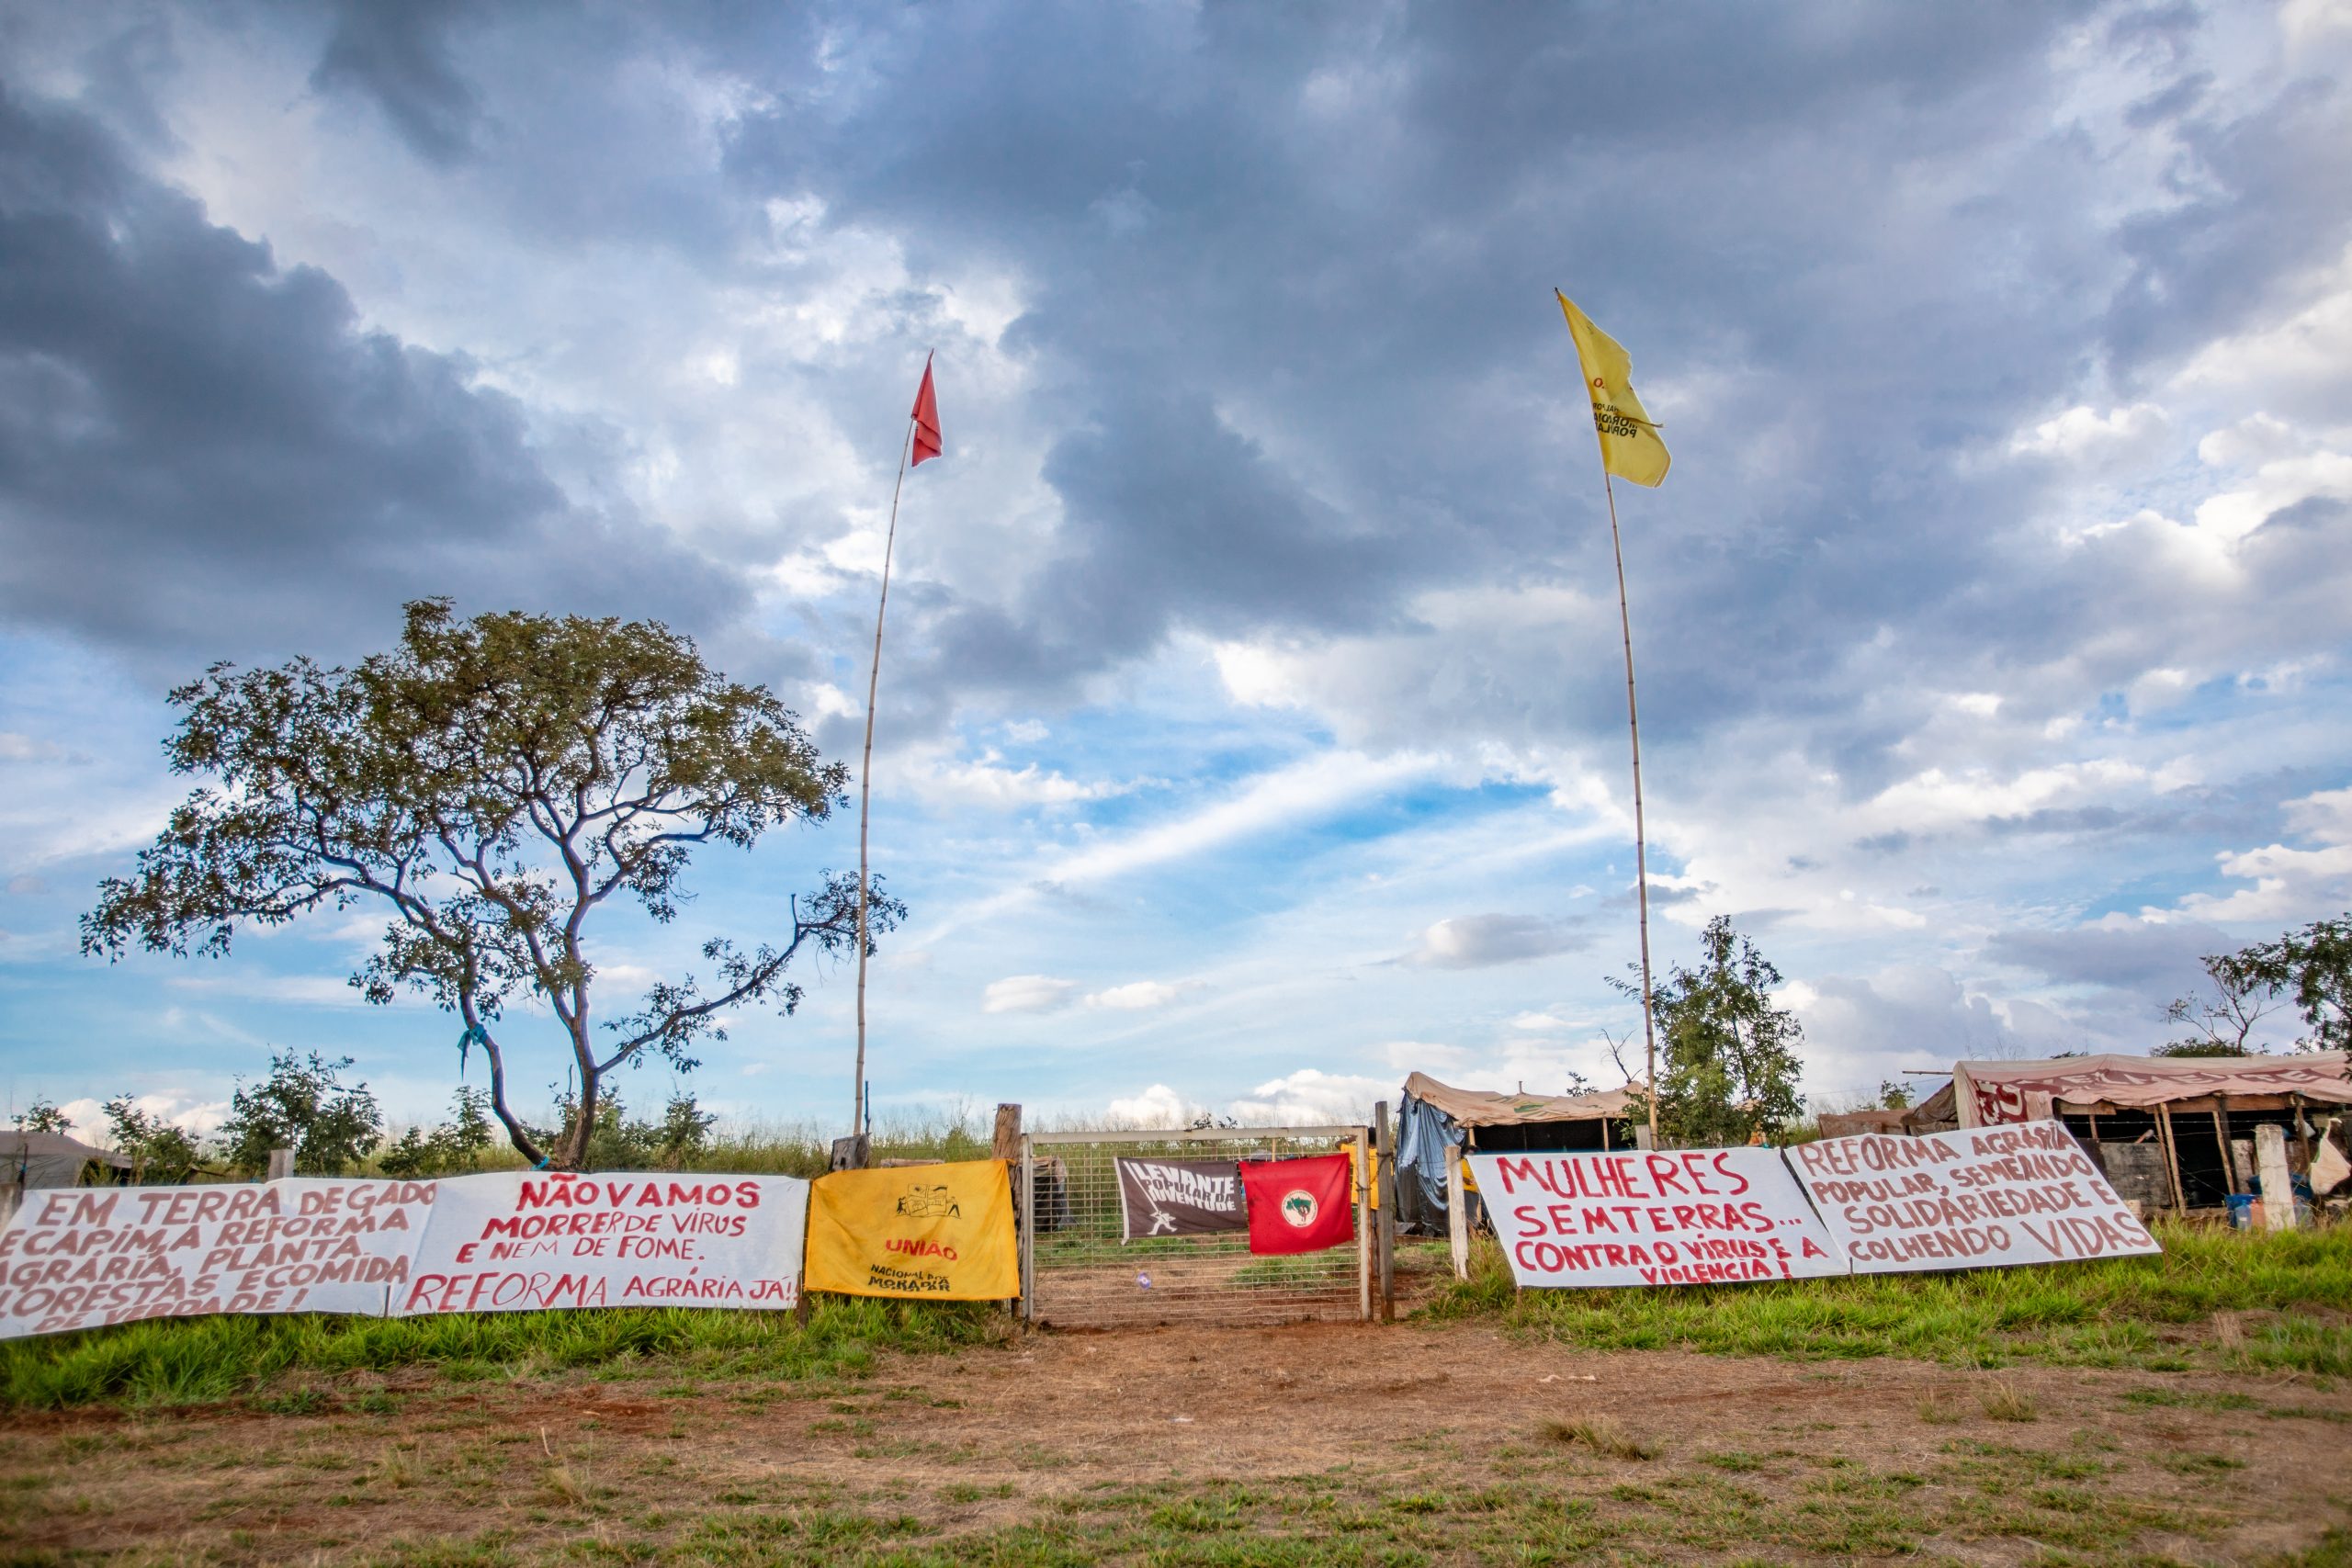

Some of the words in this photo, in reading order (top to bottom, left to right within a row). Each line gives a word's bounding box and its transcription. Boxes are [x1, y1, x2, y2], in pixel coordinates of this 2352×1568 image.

[1497, 1152, 1749, 1199] MULHERES
[1797, 1136, 1962, 1177] REFORMA
[1132, 1161, 1235, 1194] LEVANTE
[1810, 1173, 1950, 1204] POPULAR,
[1950, 1153, 2094, 1188] SEMEANDO
[2088, 1179, 2118, 1205] E
[36, 1192, 120, 1226] EM
[138, 1187, 282, 1224] TERRA
[214, 1208, 409, 1247] REFORMA
[1802, 1236, 1829, 1258] A
[1848, 1225, 2011, 1262] COLHENDO
[2019, 1212, 2154, 1258] VIDAS
[198, 1235, 362, 1274] PLANTA
[456, 1243, 480, 1263] E
[490, 1240, 559, 1261] NEM
[572, 1237, 610, 1257] DE
[616, 1235, 706, 1260] FOME.
[404, 1270, 606, 1311] REFORMA
[33, 1313, 90, 1332] DE
